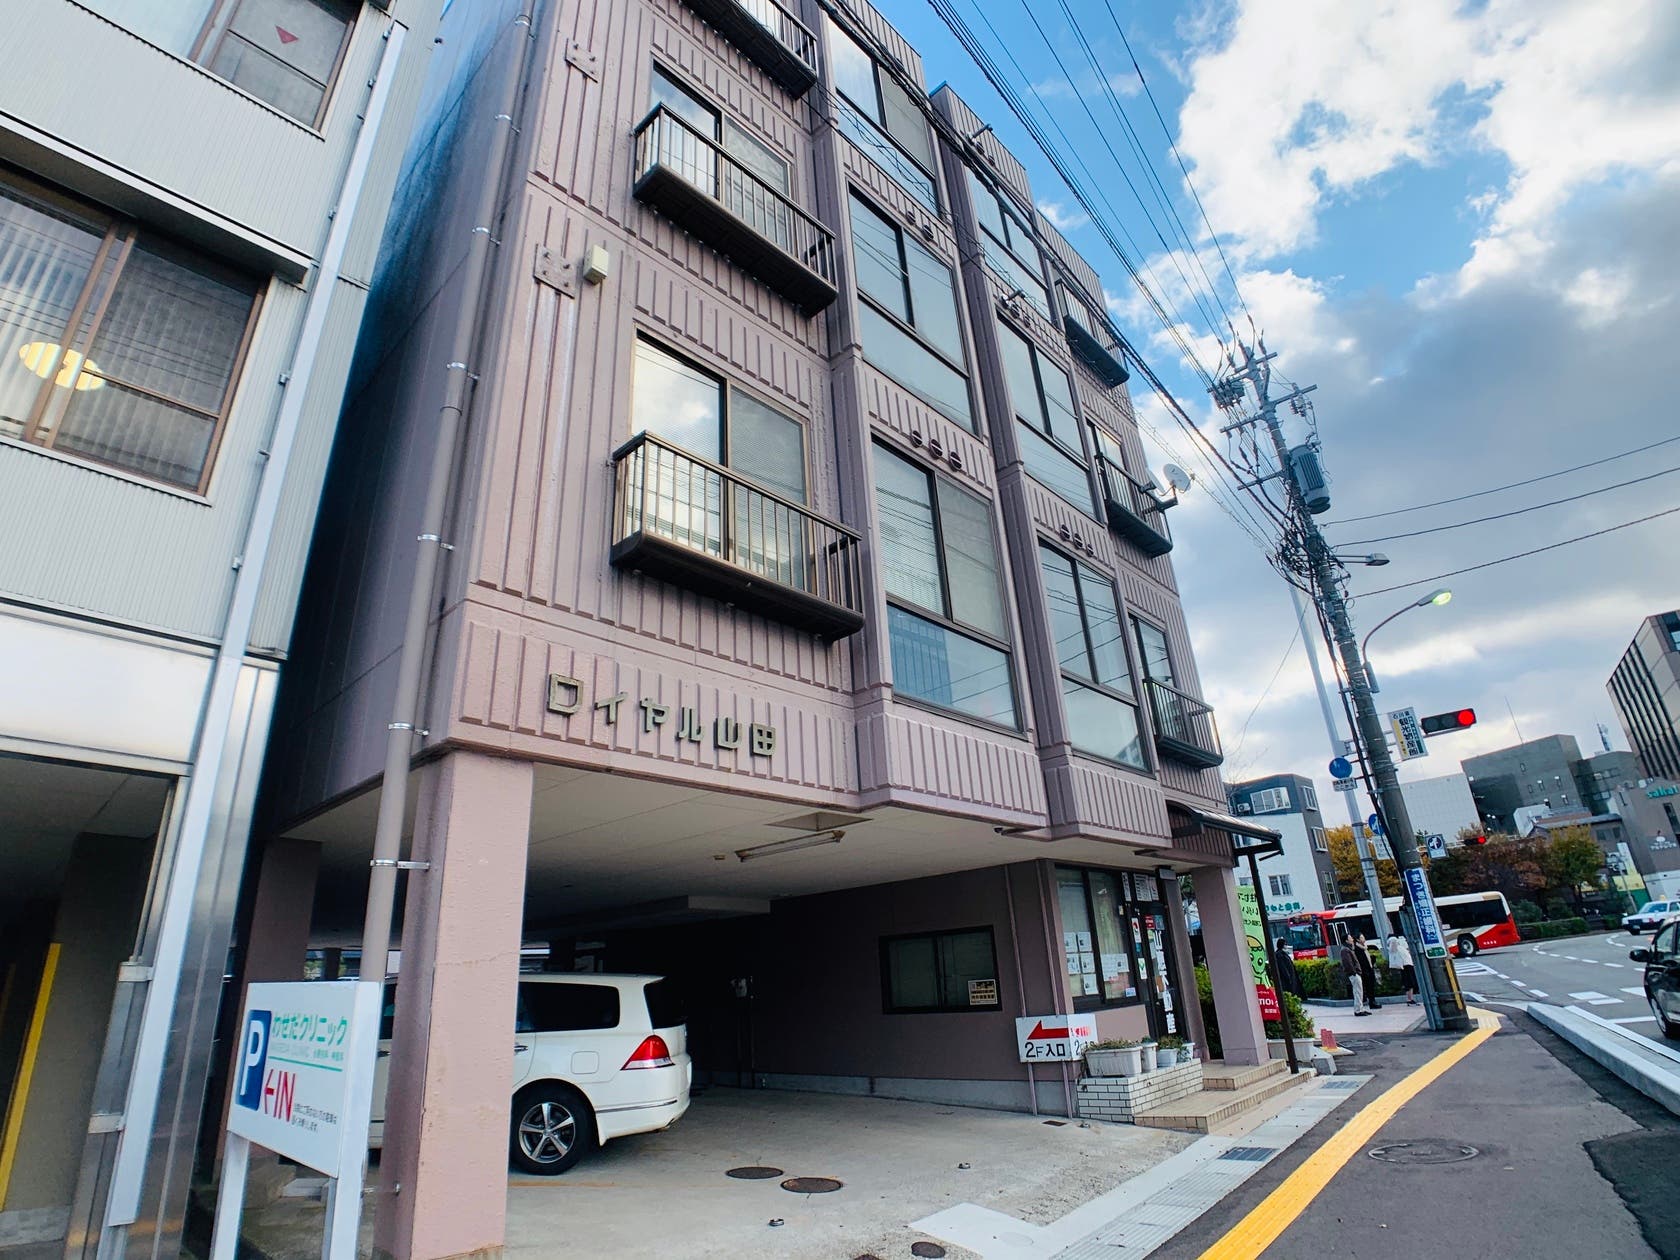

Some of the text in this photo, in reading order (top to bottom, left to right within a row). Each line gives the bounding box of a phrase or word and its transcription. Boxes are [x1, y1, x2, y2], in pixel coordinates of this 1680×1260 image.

[547, 672, 776, 757] ロイヤル山田
[272, 1013, 348, 1046] わせだクリニック
[1025, 1042, 1066, 1058] 2F入口
[240, 1020, 264, 1096] P
[273, 1070, 296, 1122] IN
